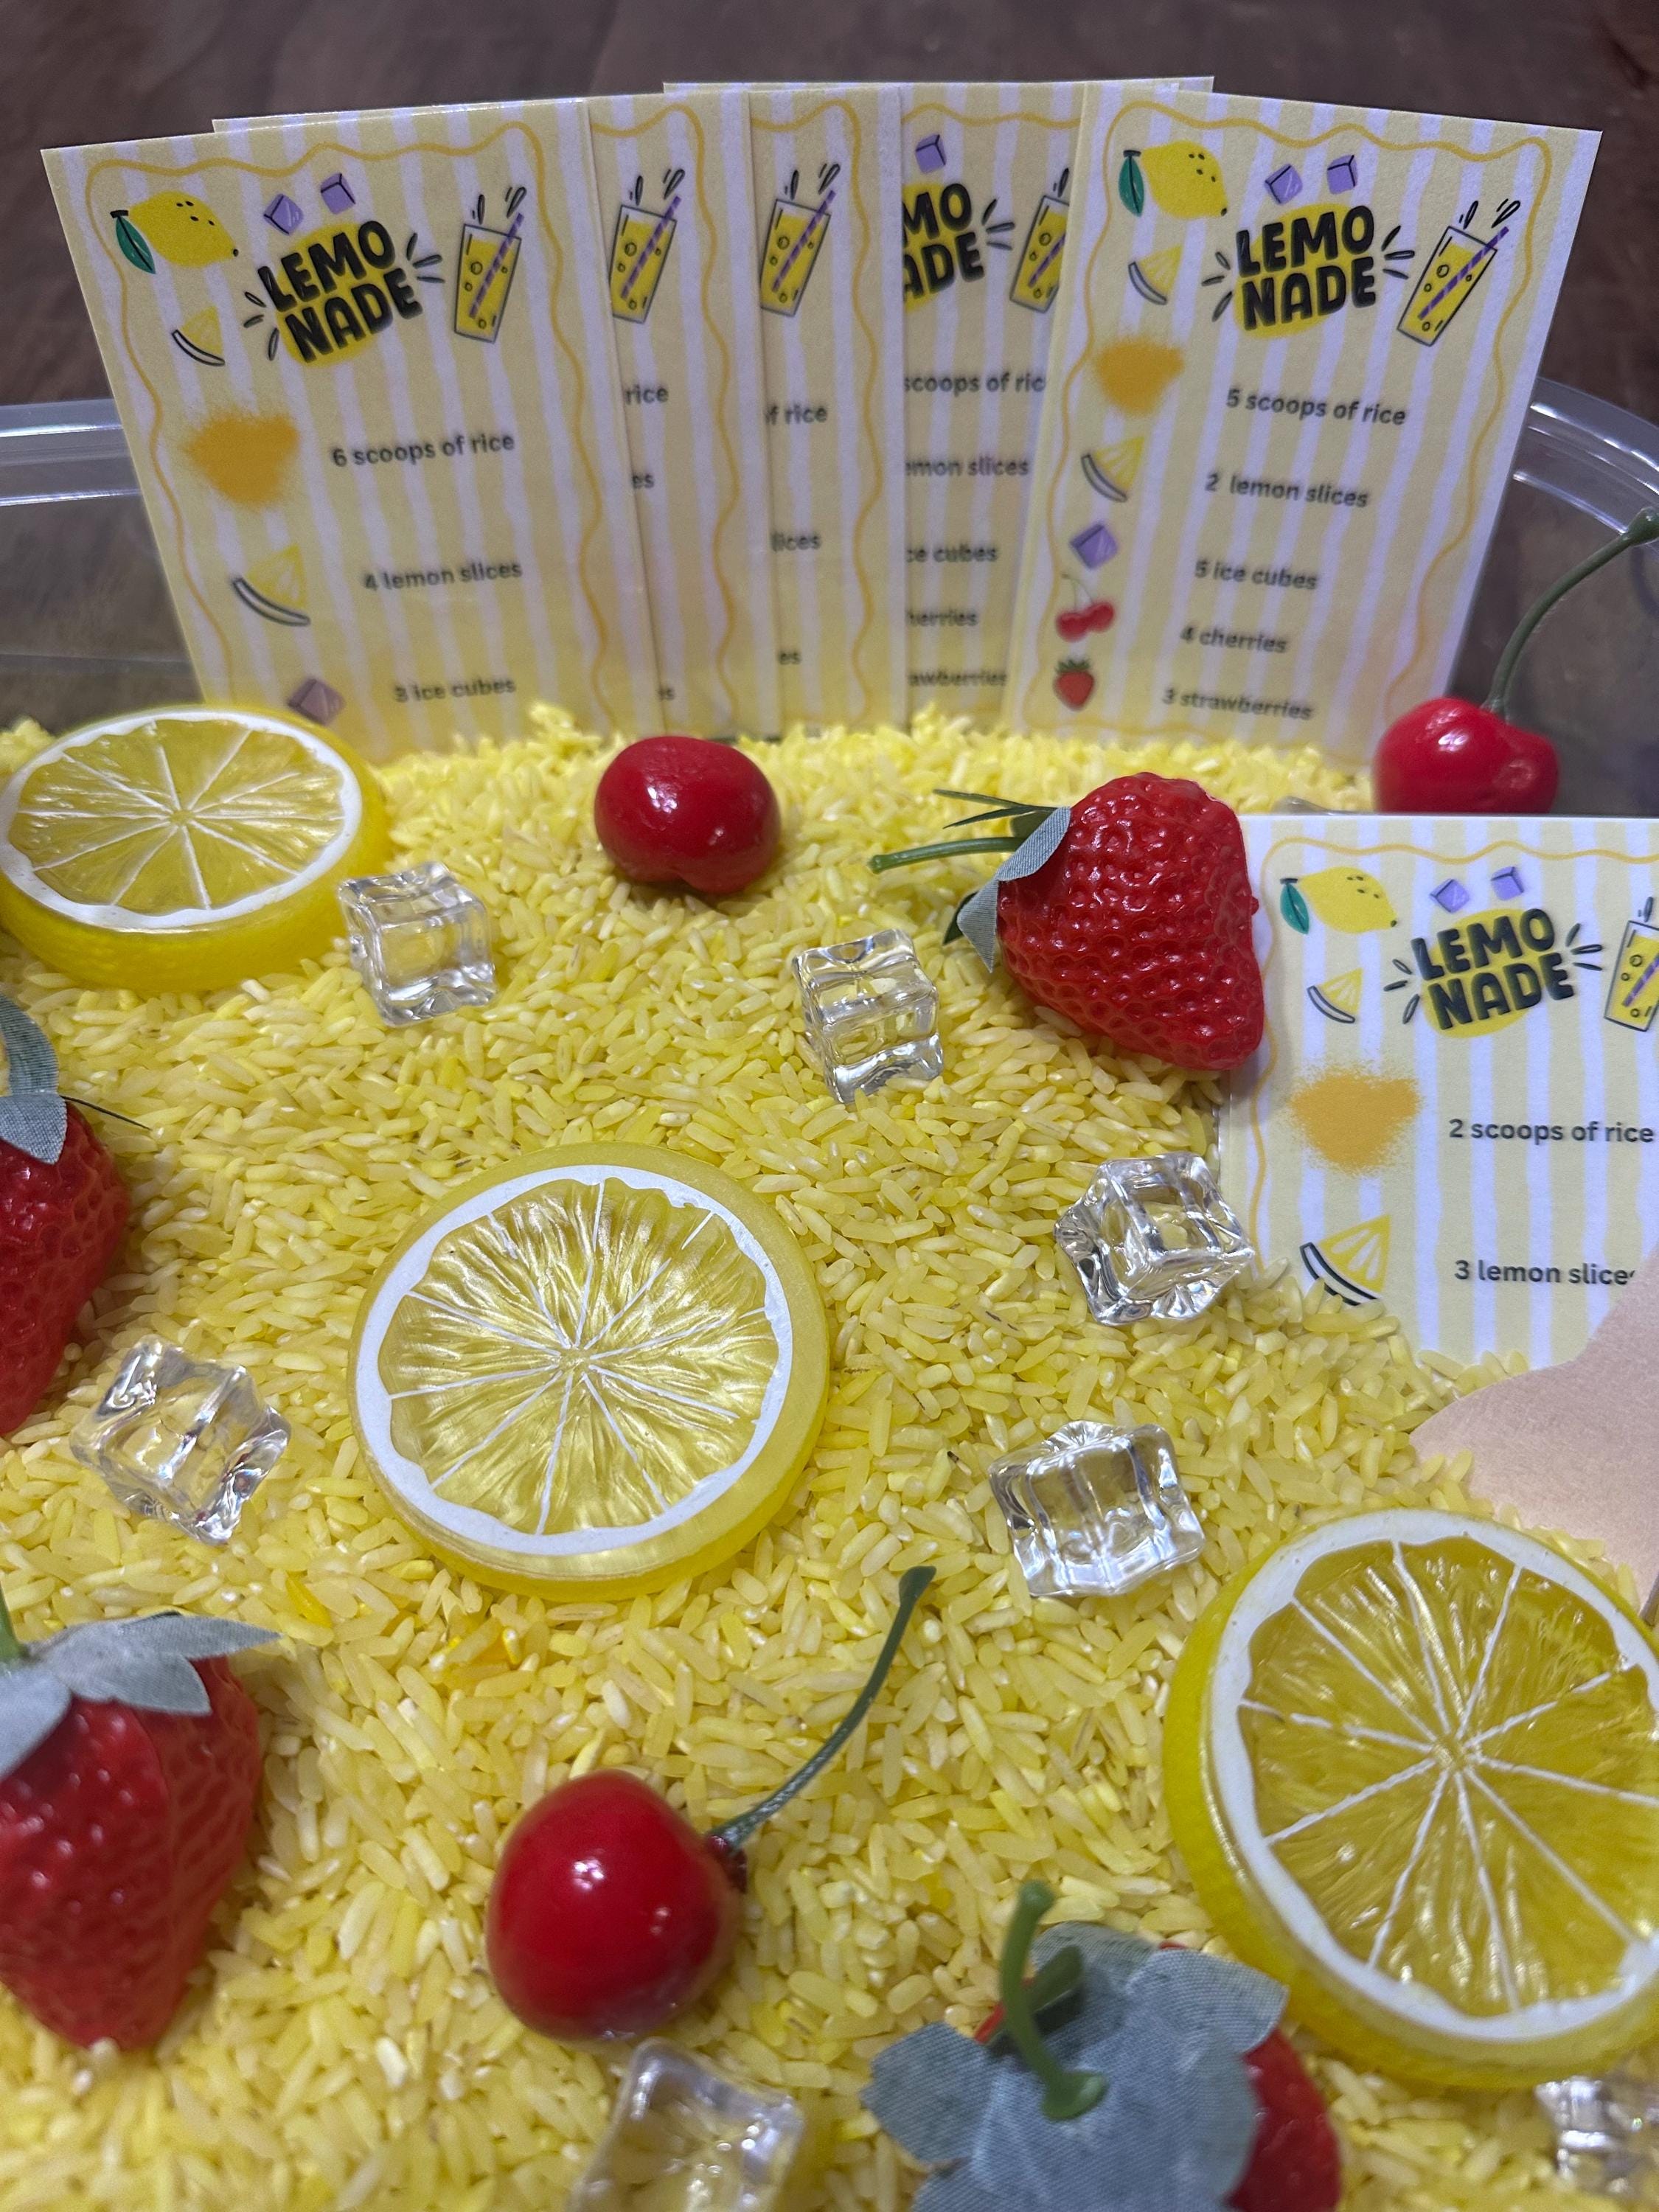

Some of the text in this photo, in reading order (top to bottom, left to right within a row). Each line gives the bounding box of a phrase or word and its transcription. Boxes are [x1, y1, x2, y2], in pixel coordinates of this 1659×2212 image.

[1236, 205, 1374, 278] LEMO
[257, 220, 395, 313] LEMO
[1242, 256, 1376, 330] NADE
[285, 268, 423, 364] NADE
[626, 383, 669, 405] rice
[986, 371, 1010, 392] of
[784, 404, 828, 424] rice
[1226, 388, 1406, 425] 5 scoops of rice
[332, 434, 515, 467] 6 scoops of rice
[967, 454, 1029, 476] slices
[1205, 472, 1368, 507] 2 lemon slices
[933, 543, 997, 563] cubes
[365, 561, 523, 591] 4 lemon slices
[1195, 559, 1318, 590] 5 ice cubes
[1180, 626, 1287, 653] 4 cherries
[412, 684, 445, 701] ice
[451, 677, 515, 698] cubes
[1180, 692, 1312, 720] strawberries
[1411, 908, 1556, 981] LEMO
[1427, 952, 1575, 1030] NADE
[1448, 1119, 1655, 1146] 2 scoops of rice
[1454, 1259, 1635, 1285] 3 lemon slice
